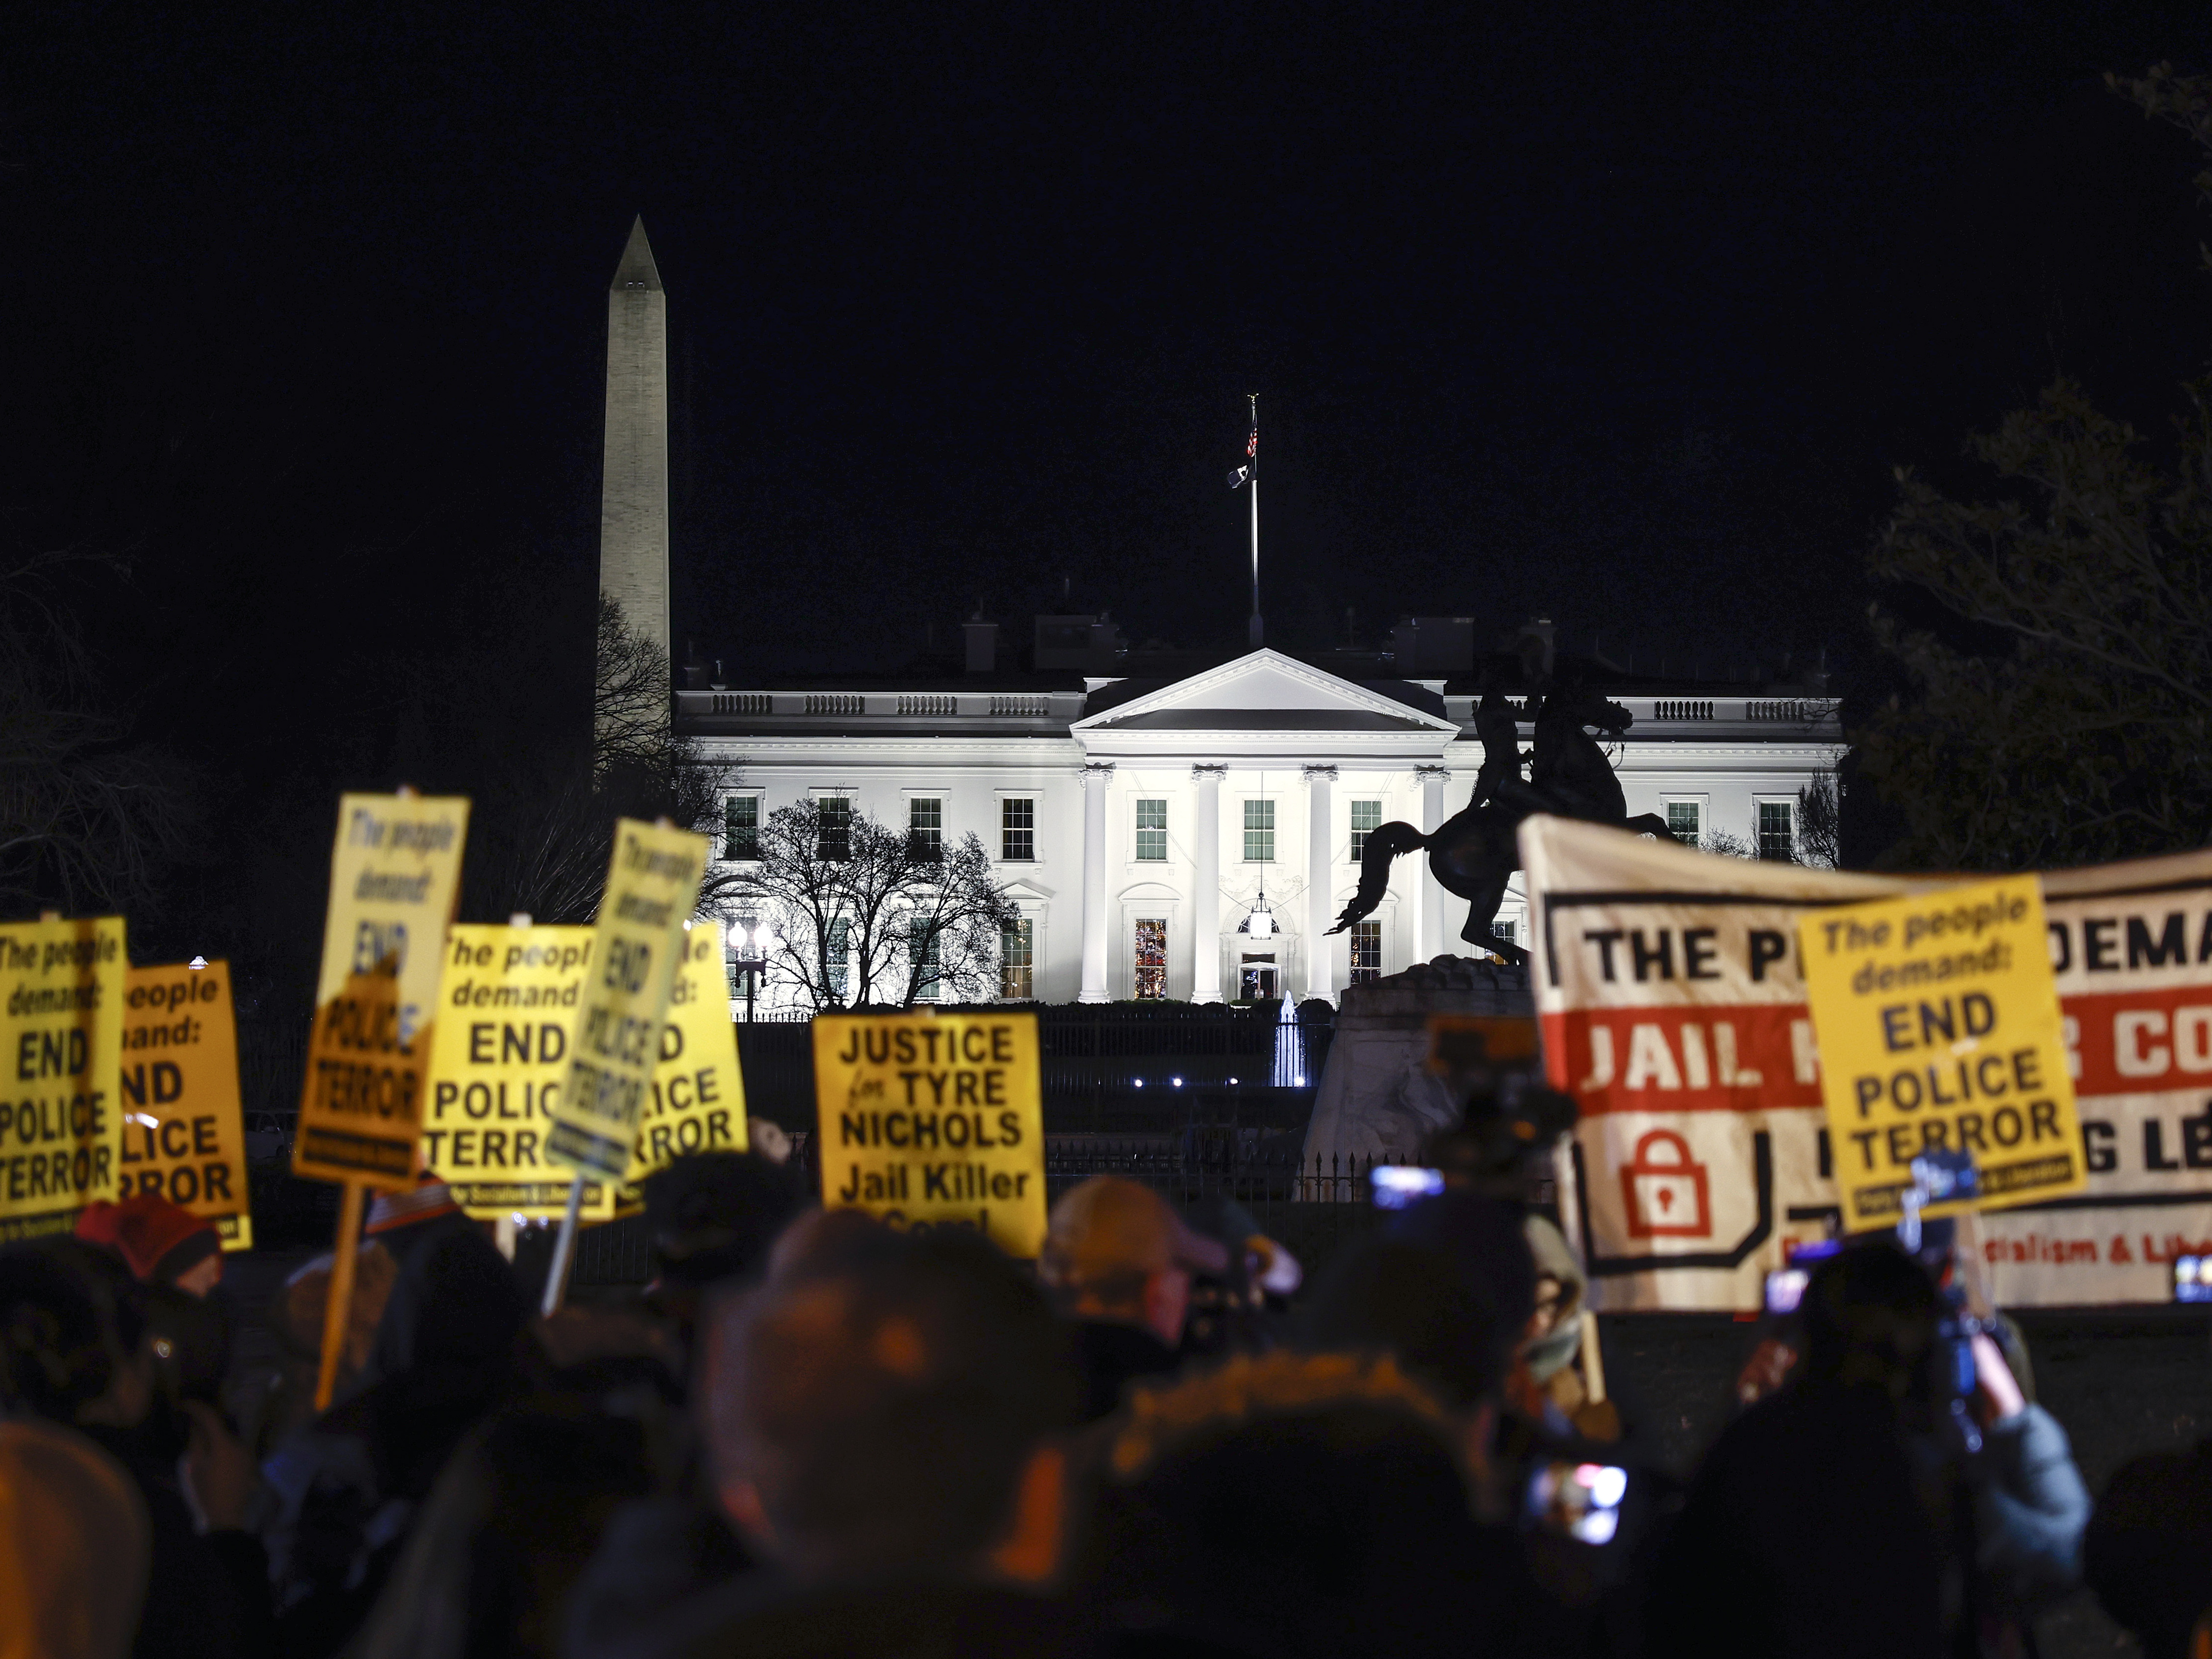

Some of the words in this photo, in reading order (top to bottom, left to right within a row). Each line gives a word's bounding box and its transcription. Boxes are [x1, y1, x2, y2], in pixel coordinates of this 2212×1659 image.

[1822, 918, 1890, 955] The
[1903, 891, 2028, 949] people
[450, 938, 493, 966] he
[503, 938, 591, 975] peopl
[1583, 926, 1721, 982] THE
[1852, 936, 2013, 995] demand:
[127, 974, 218, 1013] eople
[469, 1023, 566, 1065] END
[1881, 991, 1995, 1052] END
[18, 1028, 87, 1081] END
[840, 1026, 1014, 1064] JUSTICE
[1580, 1021, 1764, 1092] JAIL
[120, 1061, 183, 1106] ND
[435, 1081, 561, 1119] POLIC
[646, 1067, 720, 1118] ICE
[897, 1069, 1005, 1106] TYRE
[1854, 1048, 2043, 1119] POLICE
[0, 1092, 106, 1146] POLICE
[121, 1115, 218, 1162] LICE
[840, 1111, 1022, 1148] NICHOLS
[1849, 1100, 2062, 1171] TERROR
[425, 1131, 538, 1167] TERR
[840, 1163, 909, 1202] Jail
[924, 1163, 1029, 1200] Killer
[1985, 1233, 2099, 1265] cialism
